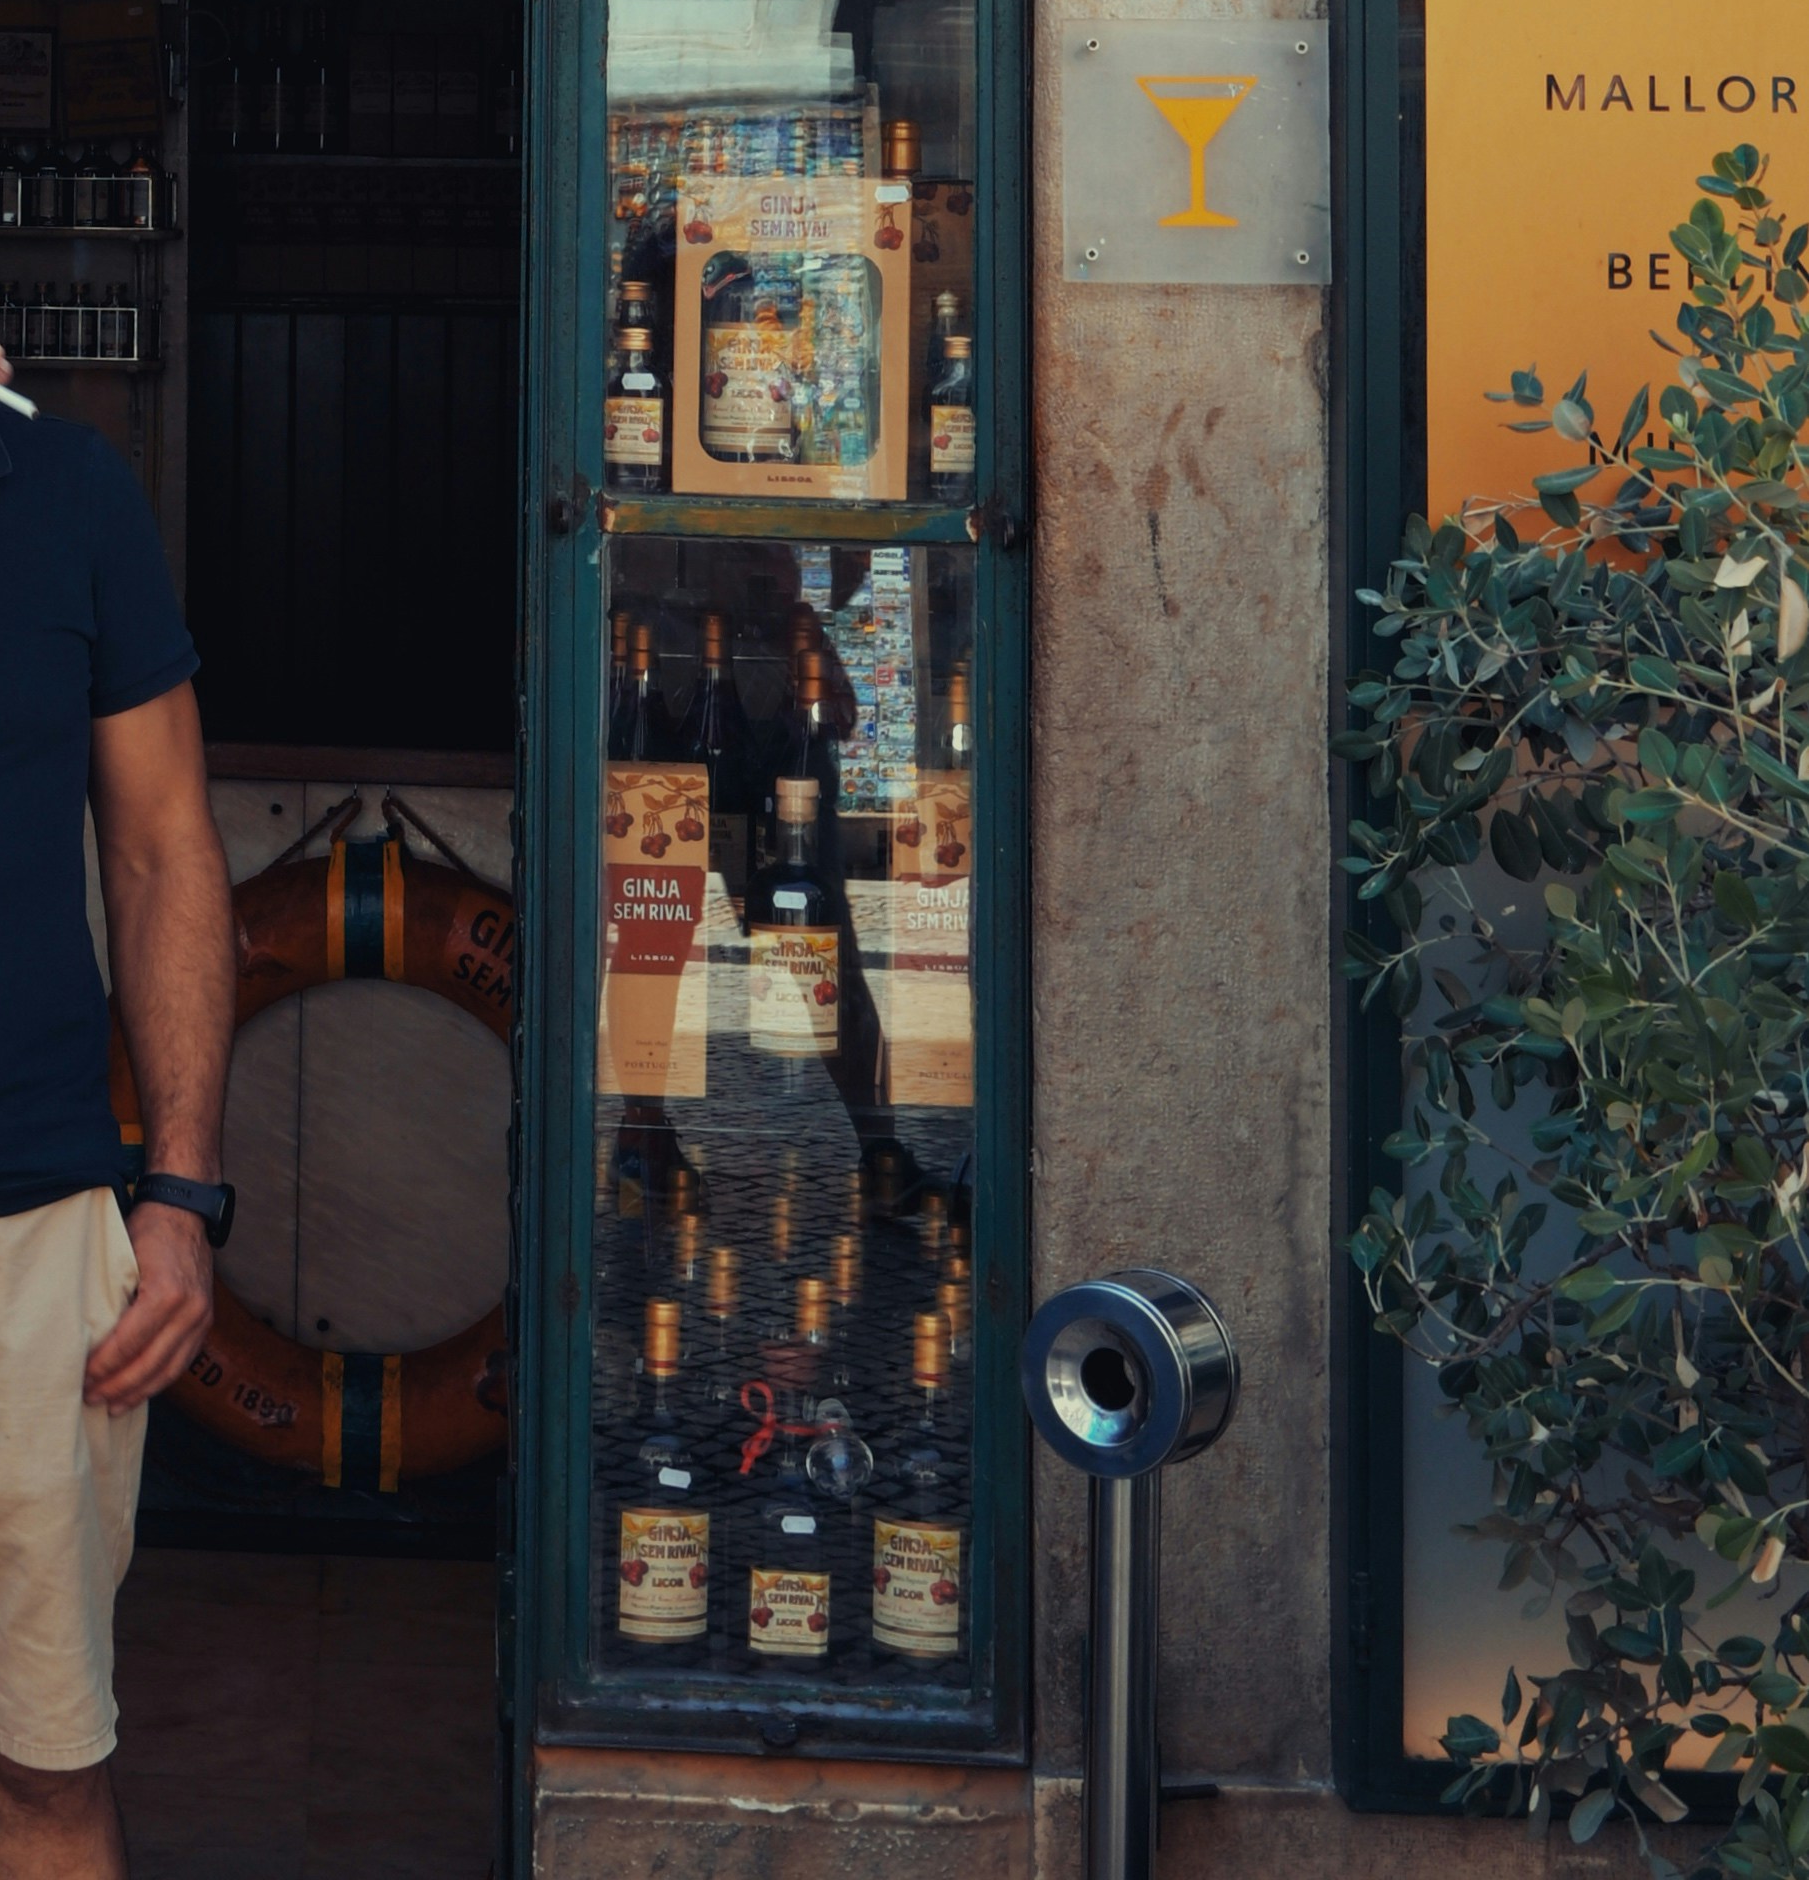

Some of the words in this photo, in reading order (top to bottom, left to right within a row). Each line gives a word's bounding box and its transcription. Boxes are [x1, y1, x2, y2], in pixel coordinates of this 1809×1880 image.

[1545, 73, 1798, 114] MALLOR
[760, 195, 817, 215] GINJA
[750, 219, 781, 237] SEM
[782, 219, 831, 238] RIVAL
[767, 474, 813, 483] LISBOA
[622, 877, 681, 899] GINJA
[613, 902, 646, 921] SEM
[648, 903, 694, 922] RIVAL
[906, 912, 940, 931] SEM
[630, 953, 676, 962] LISBOA
[789, 960, 824, 975] RIVAL
[647, 1525, 692, 1542] GINJA
[639, 1544, 665, 1559] SEM
[666, 1545, 700, 1560] RIVAL
[889, 1534, 933, 1556] GINJA
[883, 1552, 905, 1570] SEM
[906, 1557, 943, 1574] RIVAL
[652, 1577, 684, 1588] LICOR
[893, 1586, 926, 1601] LICOR
